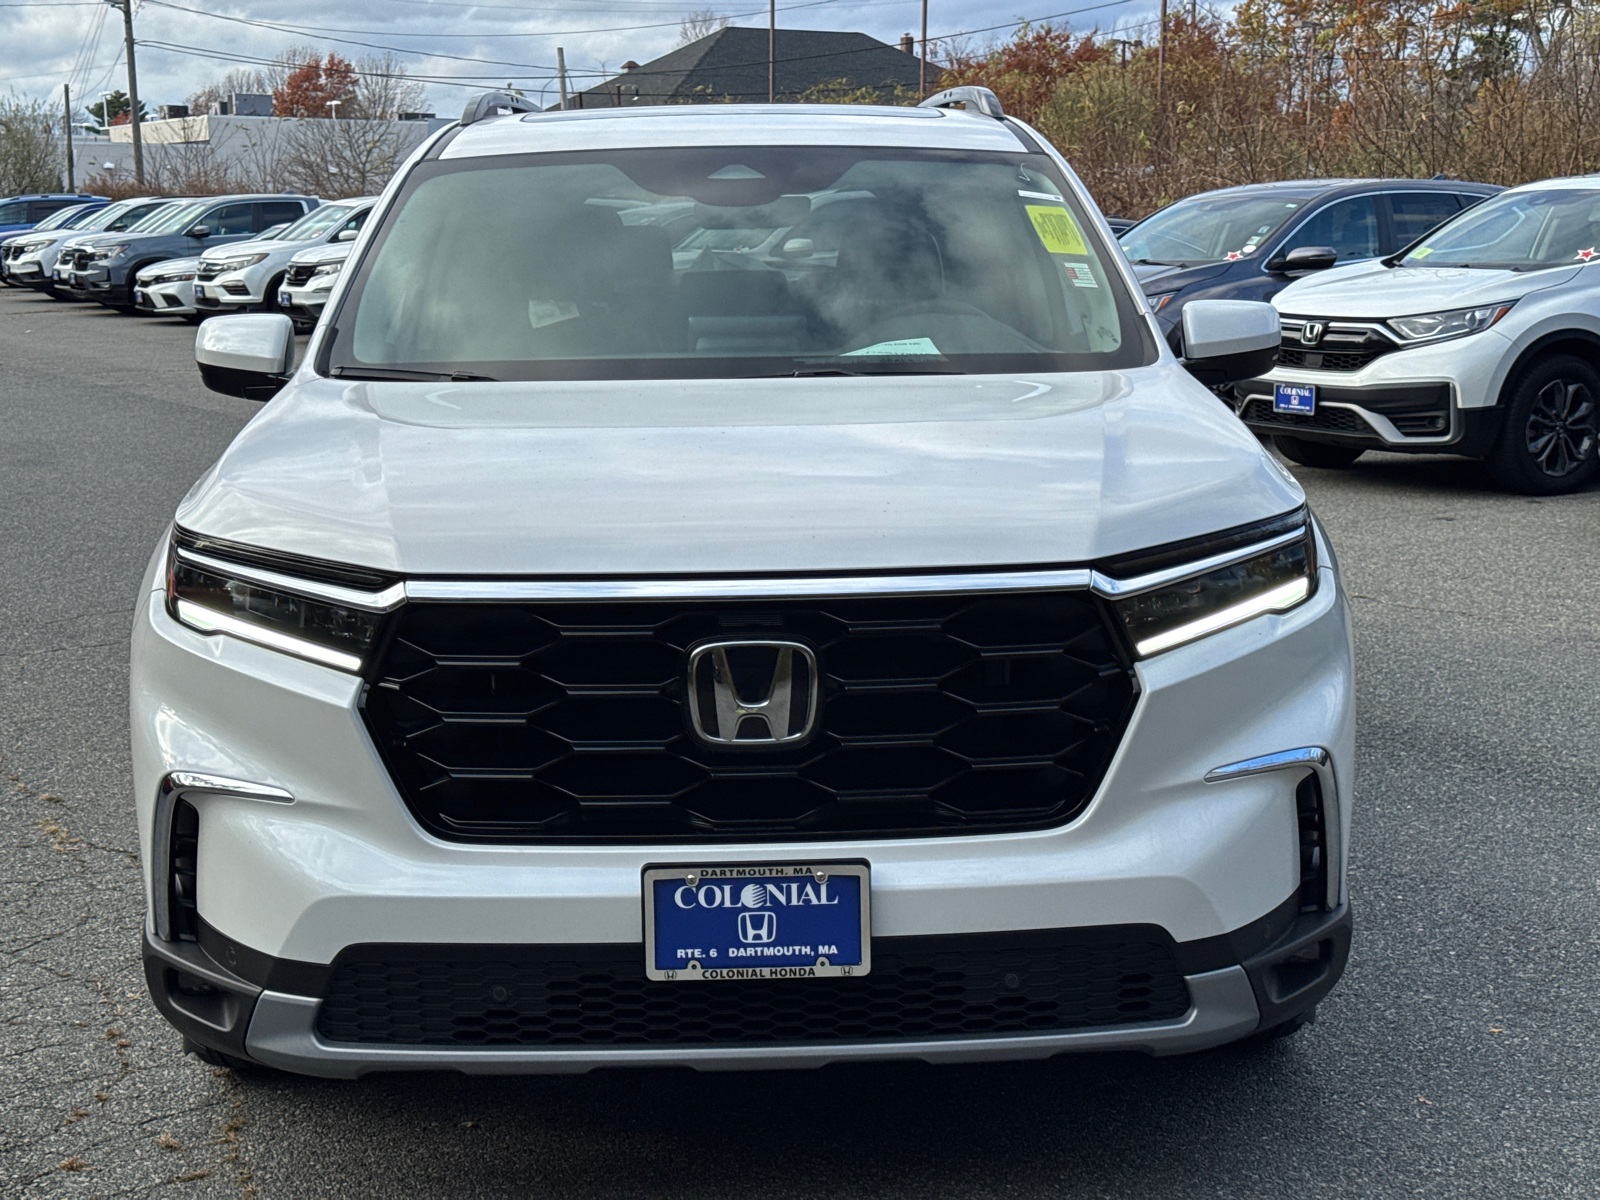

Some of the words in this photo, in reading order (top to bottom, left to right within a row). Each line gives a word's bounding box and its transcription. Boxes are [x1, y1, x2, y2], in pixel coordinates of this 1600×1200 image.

[700, 868, 788, 877] DARTMOUTH,
[792, 867, 813, 876] MA
[674, 882, 839, 909] COLONIAL
[677, 949, 706, 958] RTE.
[709, 948, 718, 958] 6
[728, 946, 815, 957] DARTMOUTH,
[818, 945, 838, 955] MA
[702, 969, 766, 979] COLONIAL
[769, 967, 816, 977] HONDA
